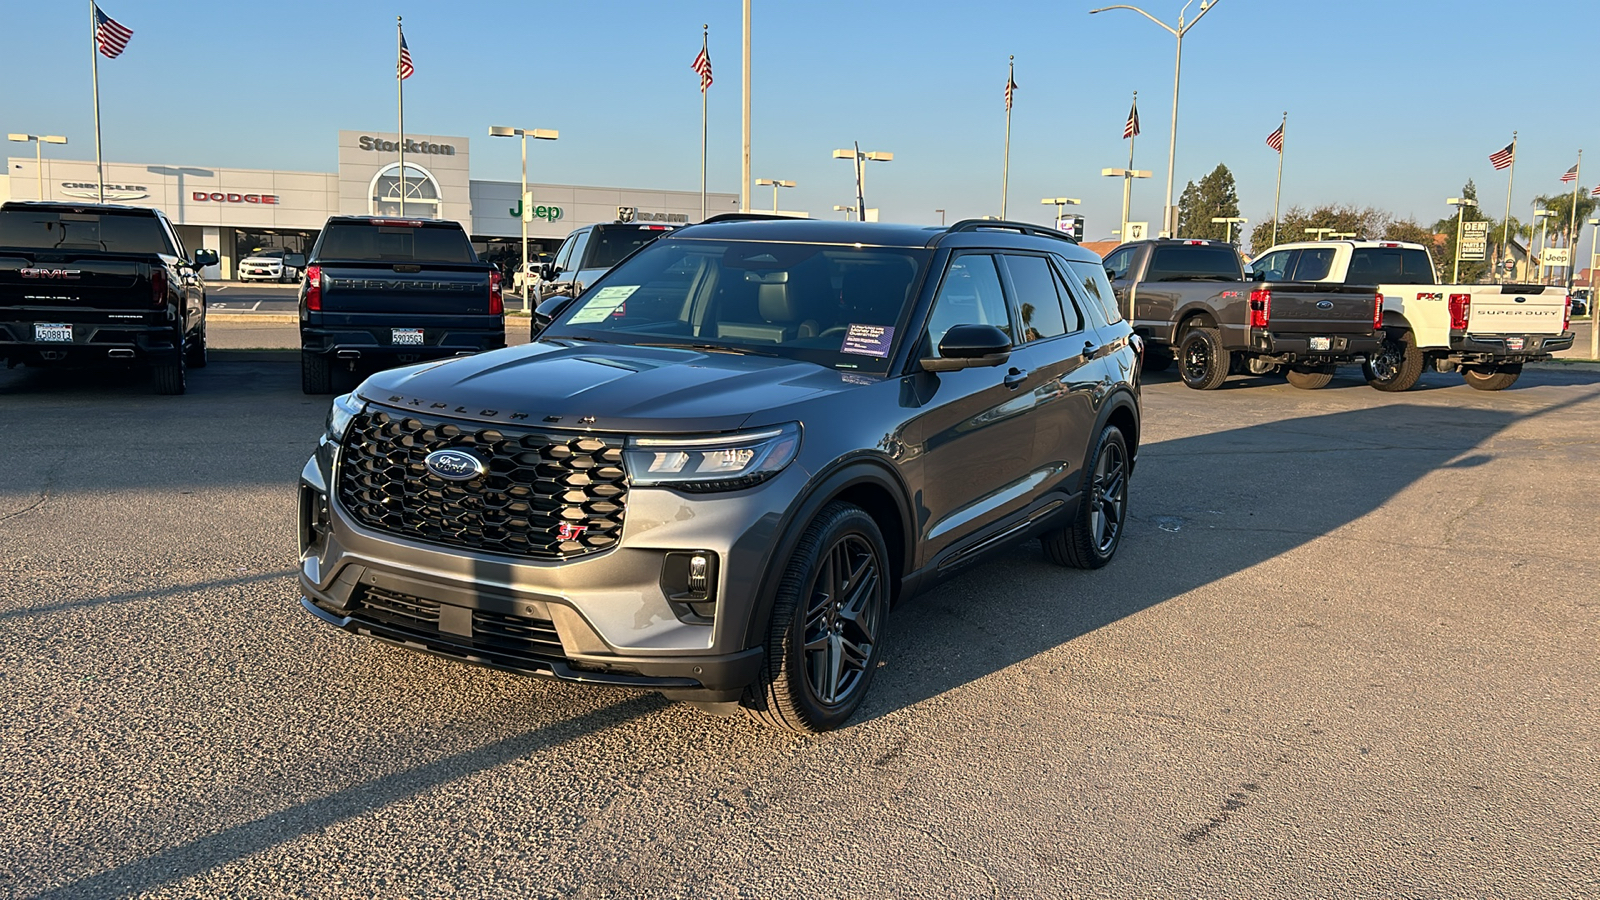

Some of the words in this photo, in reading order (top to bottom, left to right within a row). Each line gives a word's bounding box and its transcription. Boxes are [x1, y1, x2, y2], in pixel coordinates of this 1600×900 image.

[359, 135, 455, 156] Stockton
[192, 191, 279, 205] DODGE
[509, 199, 561, 222] Jep
[637, 212, 688, 223] RAM
[1464, 223, 1486, 231] OEM
[1545, 254, 1567, 262] Jeep
[20, 267, 81, 279] GMC
[333, 278, 481, 291] CHEVROLET
[1222, 291, 1244, 299] FX4
[1416, 292, 1443, 301] FX4
[388, 396, 597, 426] EXPLORER
[434, 454, 468, 474] Ford
[556, 522, 588, 541] ST
